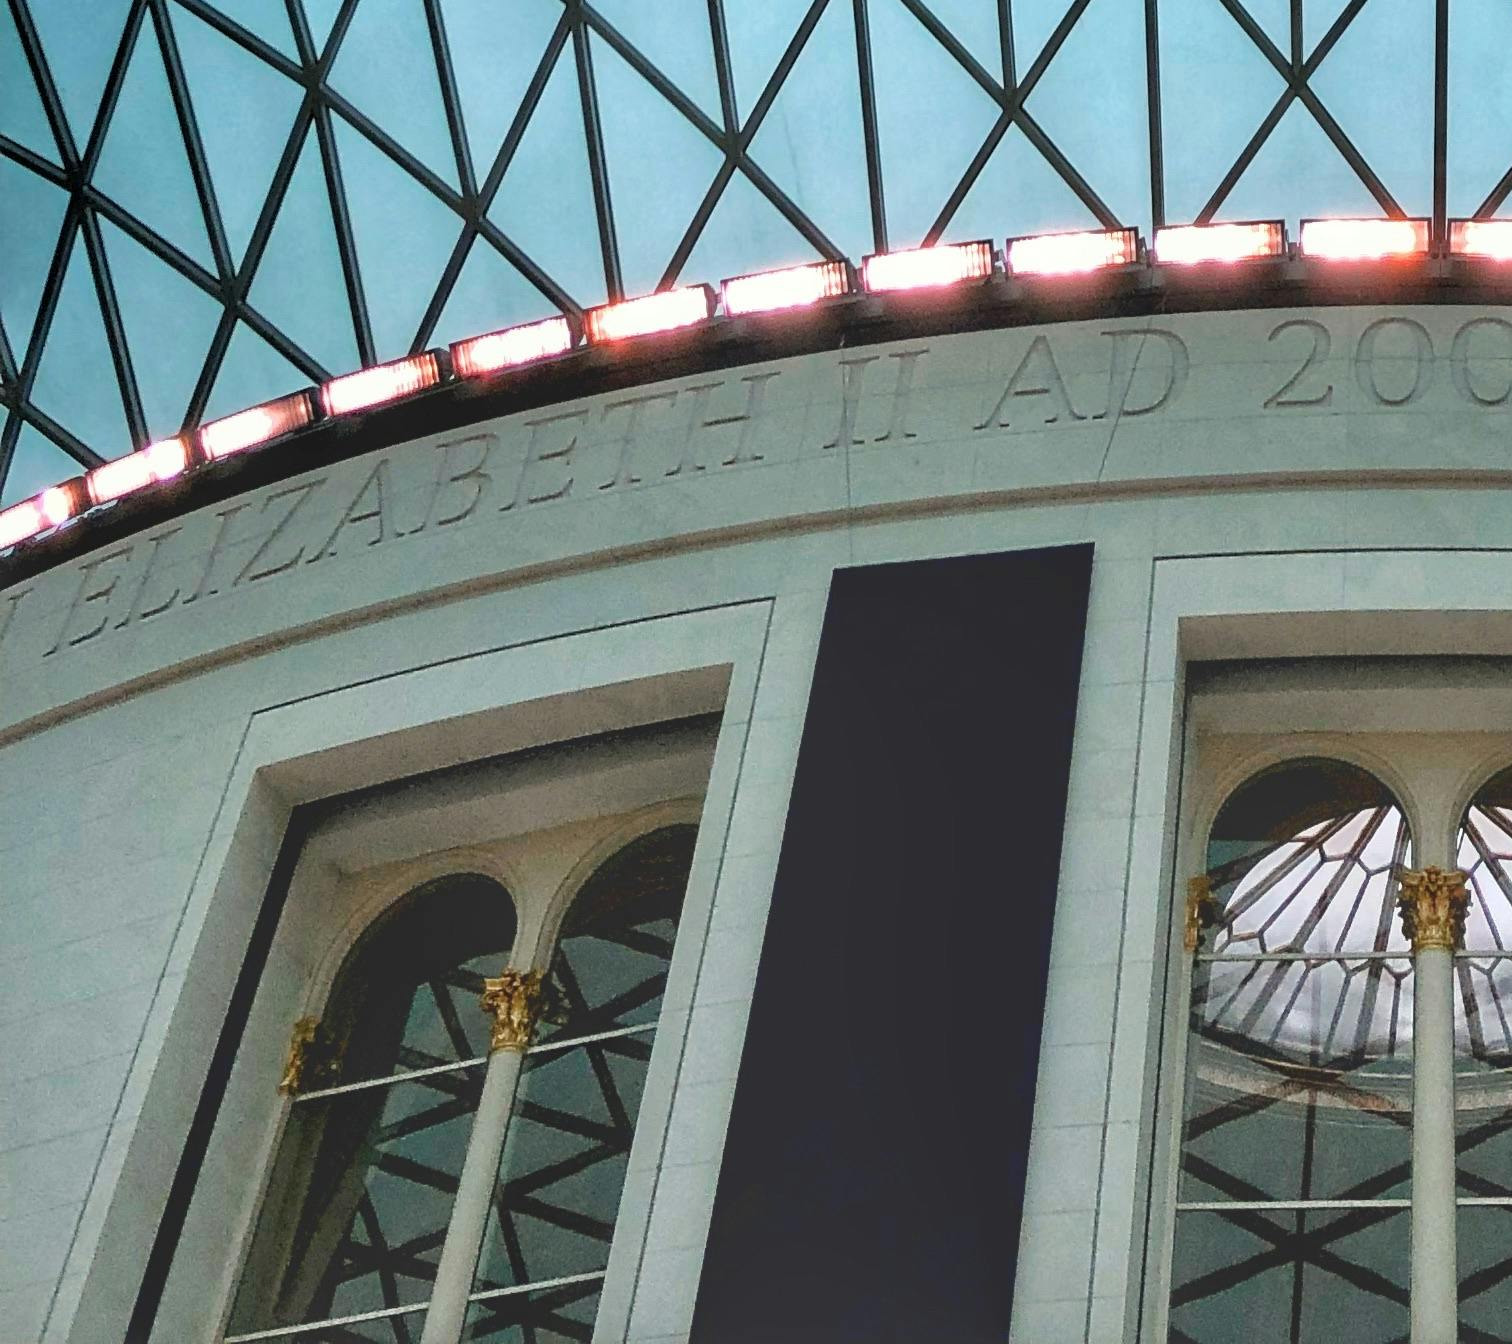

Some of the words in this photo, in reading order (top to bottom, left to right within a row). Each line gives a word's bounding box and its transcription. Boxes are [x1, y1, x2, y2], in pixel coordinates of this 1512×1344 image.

[43, 371, 781, 657] ELIZABETH
[822, 347, 931, 449] II
[974, 328, 1190, 430] AD
